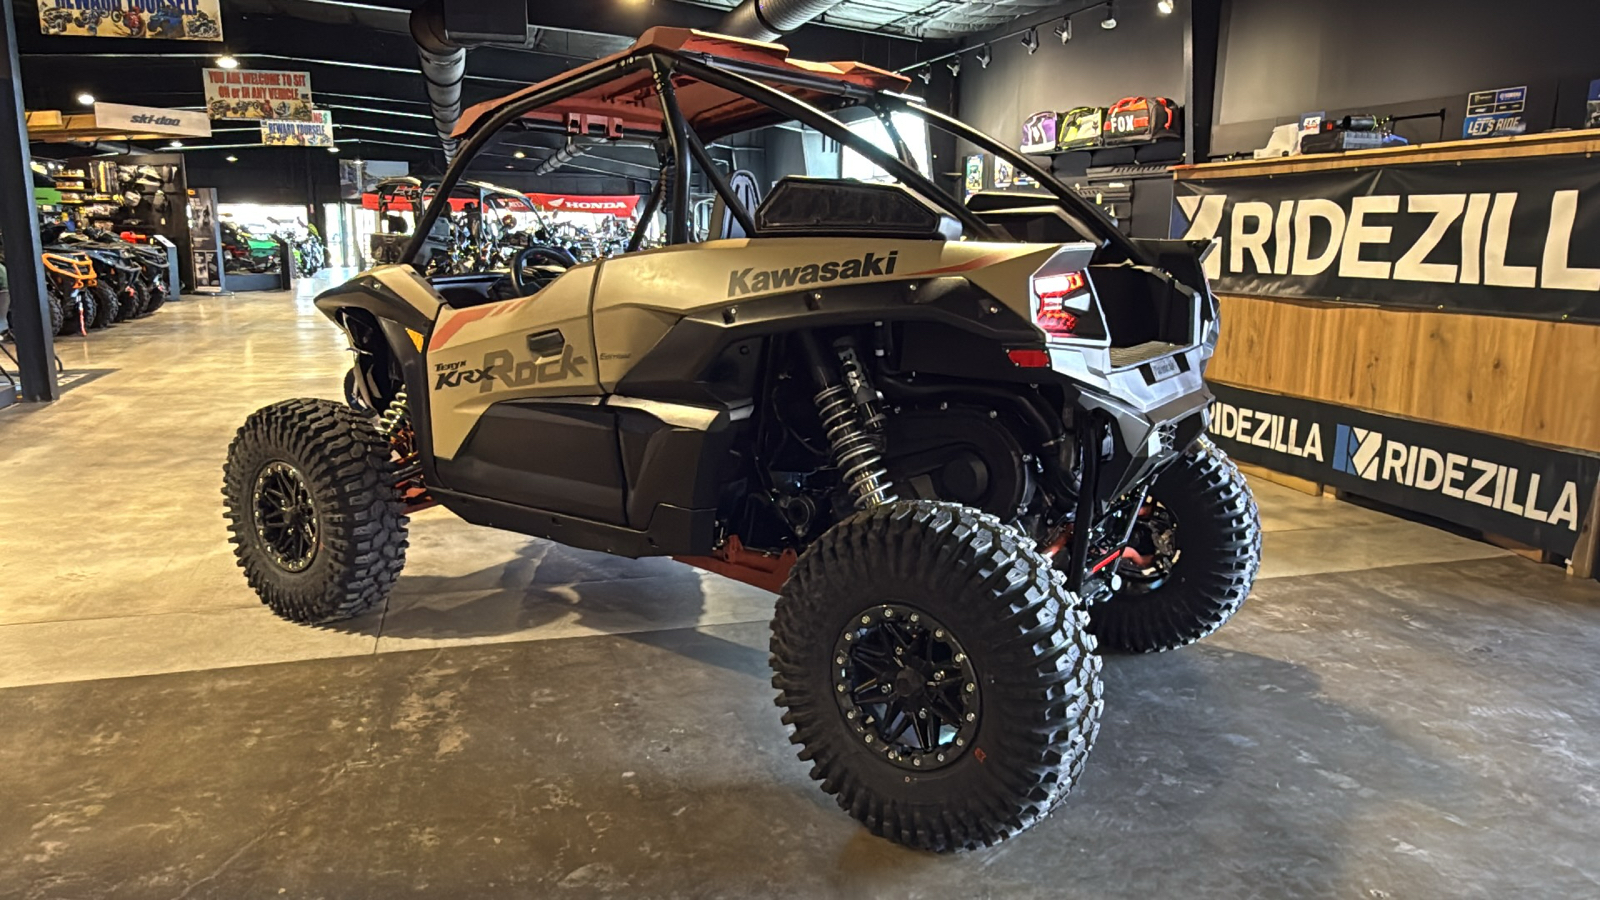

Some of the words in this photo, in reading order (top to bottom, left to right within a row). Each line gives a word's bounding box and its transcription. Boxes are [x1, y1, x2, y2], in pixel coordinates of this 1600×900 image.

[208, 71, 225, 83] YOU
[226, 71, 241, 84] ARE
[242, 72, 280, 86] WELCOME
[281, 74, 292, 86] TO
[293, 74, 306, 87] SIT
[218, 86, 230, 98] ON
[241, 86, 250, 98] IN
[251, 87, 267, 99] ANY
[268, 87, 299, 100] VEHICLE
[130, 113, 181, 127] ski-doo
[1110, 115, 1135, 133] FOX
[1467, 119, 1496, 136] LET'S
[1495, 116, 1521, 131] RIDE
[564, 201, 627, 209] HONDA
[727, 250, 898, 297] Kawasaki
[434, 365, 497, 391] KRX
[479, 344, 588, 394] Rock
[1382, 440, 1578, 532] RIDEZILLA
